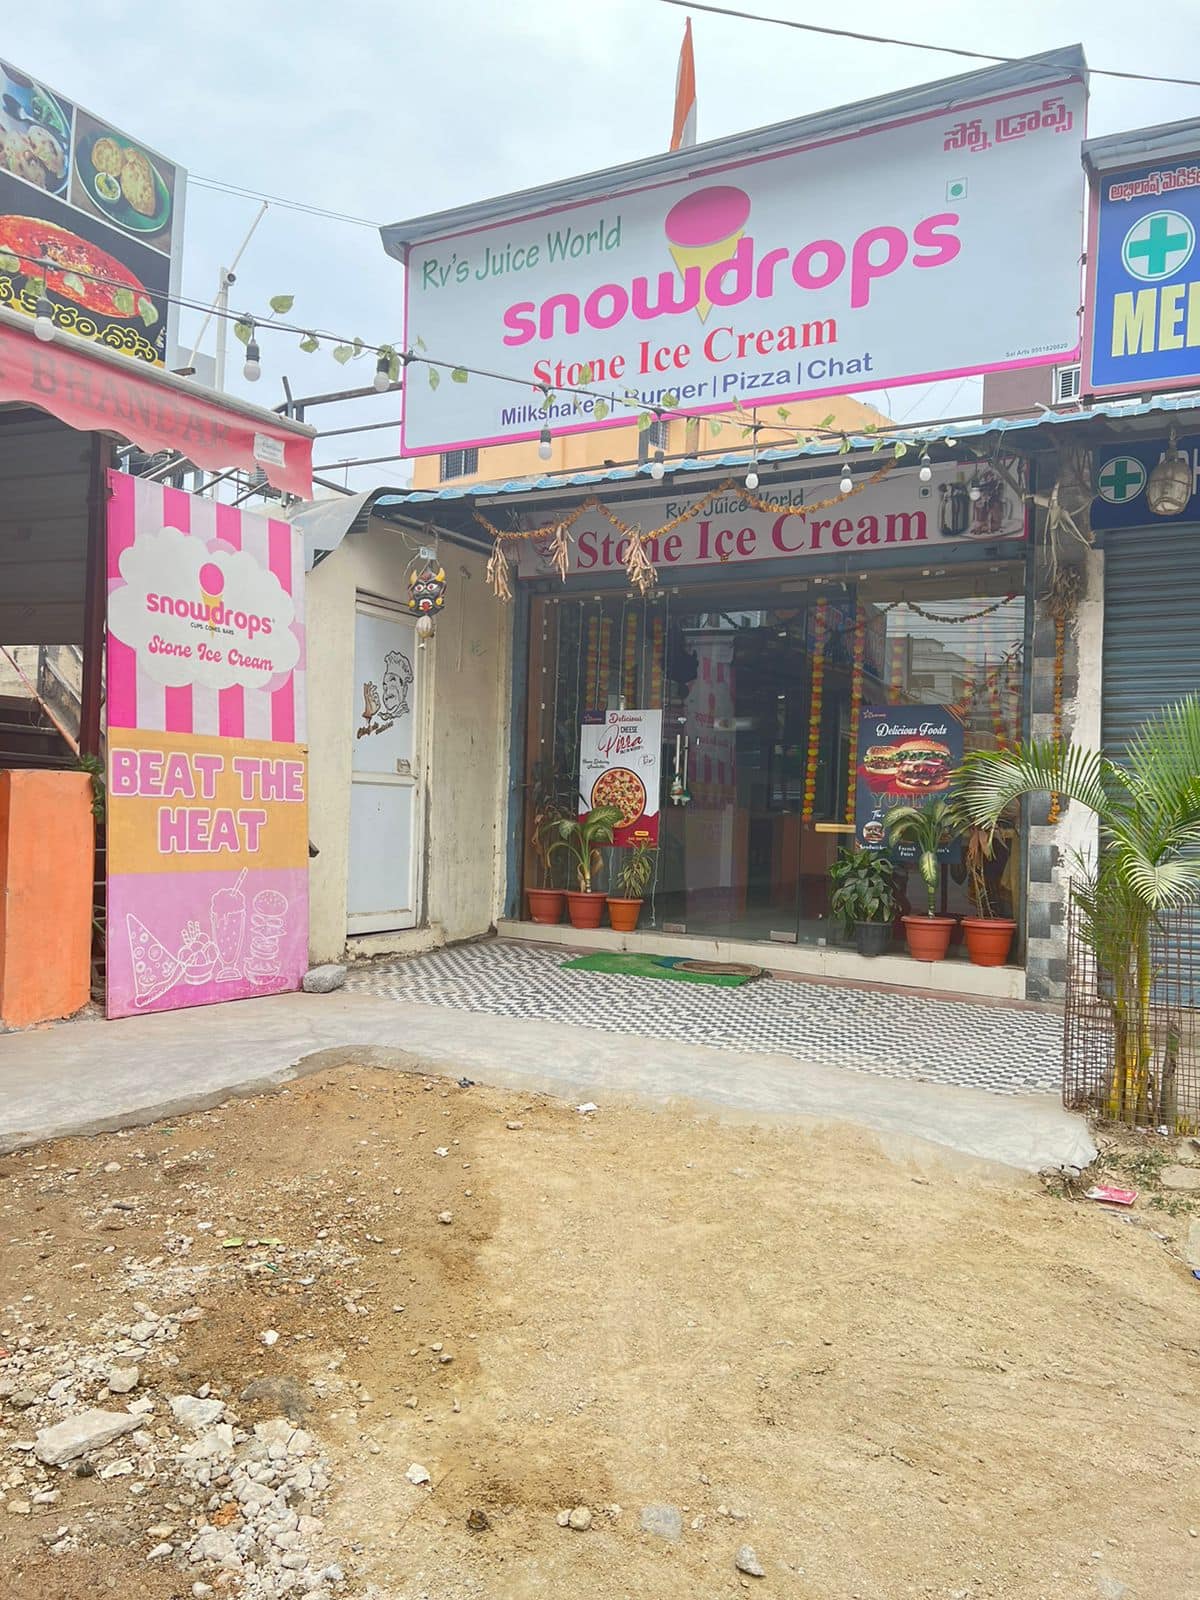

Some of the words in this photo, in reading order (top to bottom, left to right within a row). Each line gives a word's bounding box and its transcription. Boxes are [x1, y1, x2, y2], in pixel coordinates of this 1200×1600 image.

[1161, 167, 1200, 193] మెడిక
[423, 253, 470, 290] Rv's
[475, 243, 540, 281] Juice
[547, 216, 622, 263] World
[502, 213, 962, 347] snowdrops
[532, 353, 626, 392] Stone
[639, 341, 691, 375] Ice
[703, 318, 838, 364] Cream
[722, 369, 791, 393] Pizza
[807, 352, 873, 380] Chat
[703, 497, 748, 518] Juice
[696, 520, 757, 560] Ice
[771, 510, 929, 553] Cream
[146, 592, 273, 640] snowdrops
[148, 635, 193, 658] Stone
[197, 643, 223, 663] Ice
[228, 649, 273, 672] Cream
[608, 712, 643, 724] Delicious
[876, 722, 917, 737] Delicious
[919, 722, 948, 737] Foods
[598, 725, 643, 758] Pizza
[110, 748, 224, 799] BEAT
[234, 756, 305, 802] THE
[158, 807, 267, 853] HEAT
